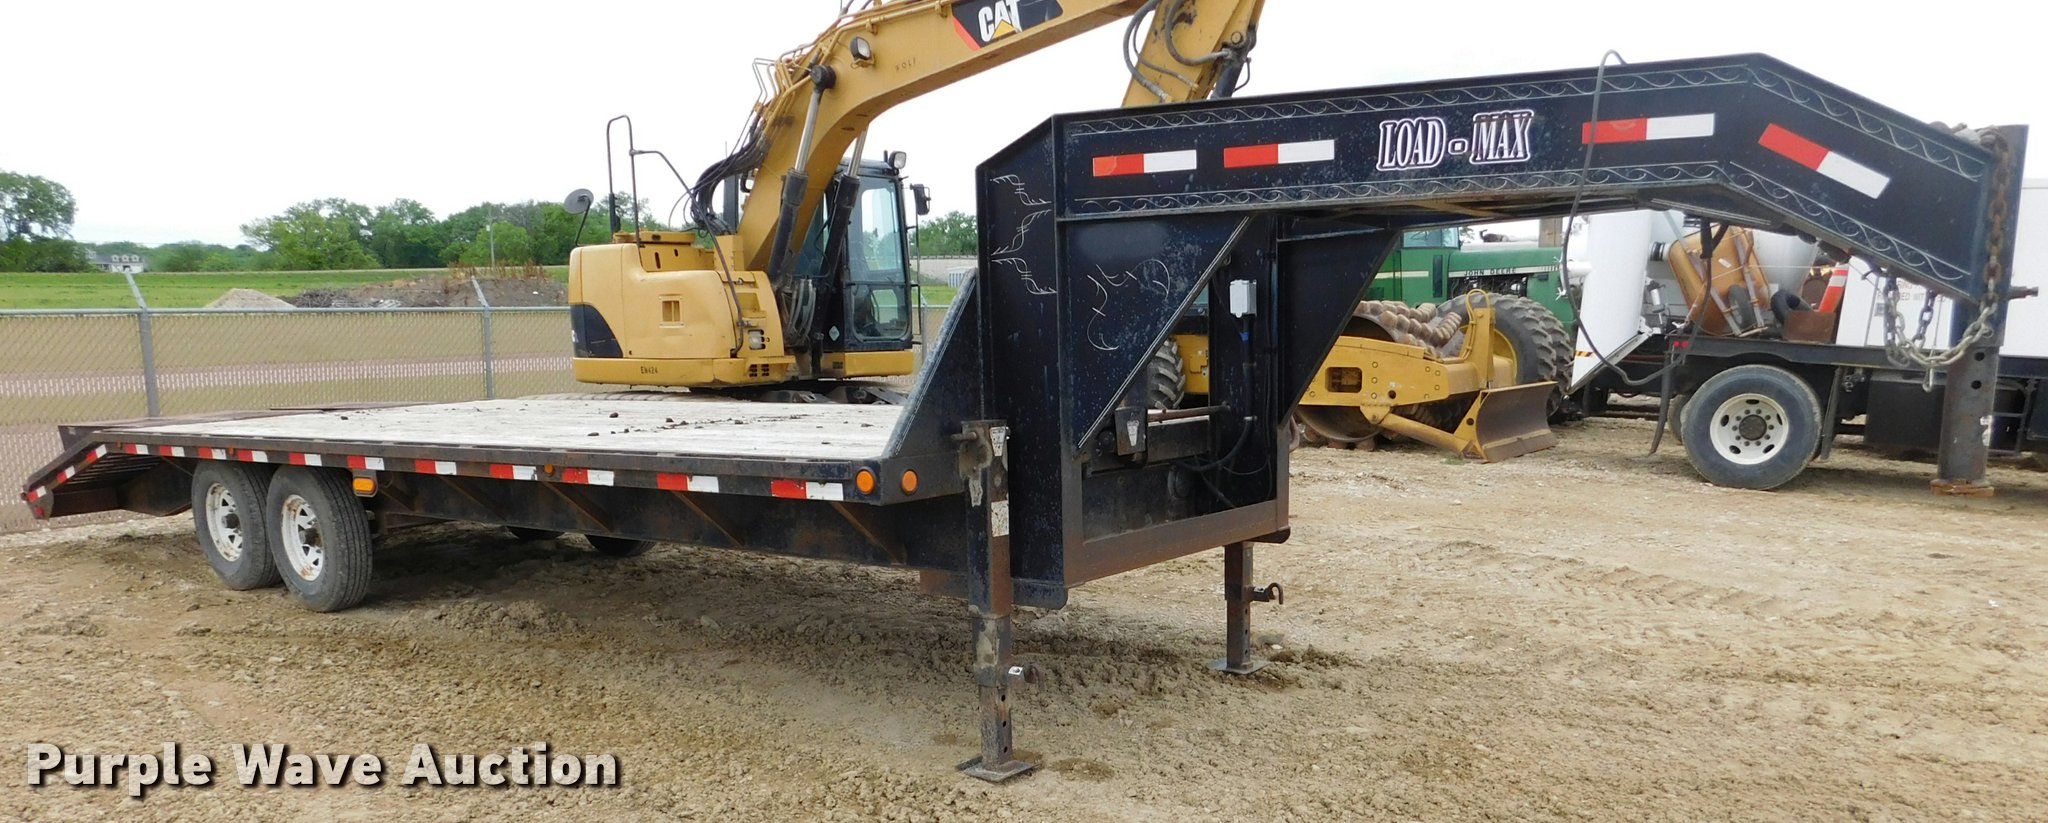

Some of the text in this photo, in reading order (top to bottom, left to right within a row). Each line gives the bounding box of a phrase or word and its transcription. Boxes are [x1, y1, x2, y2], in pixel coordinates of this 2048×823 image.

[978, 0, 1022, 42] CAT
[1377, 116, 1446, 171] LOAD
[1469, 109, 1534, 164] MAX
[1490, 267, 1517, 275] DEERE
